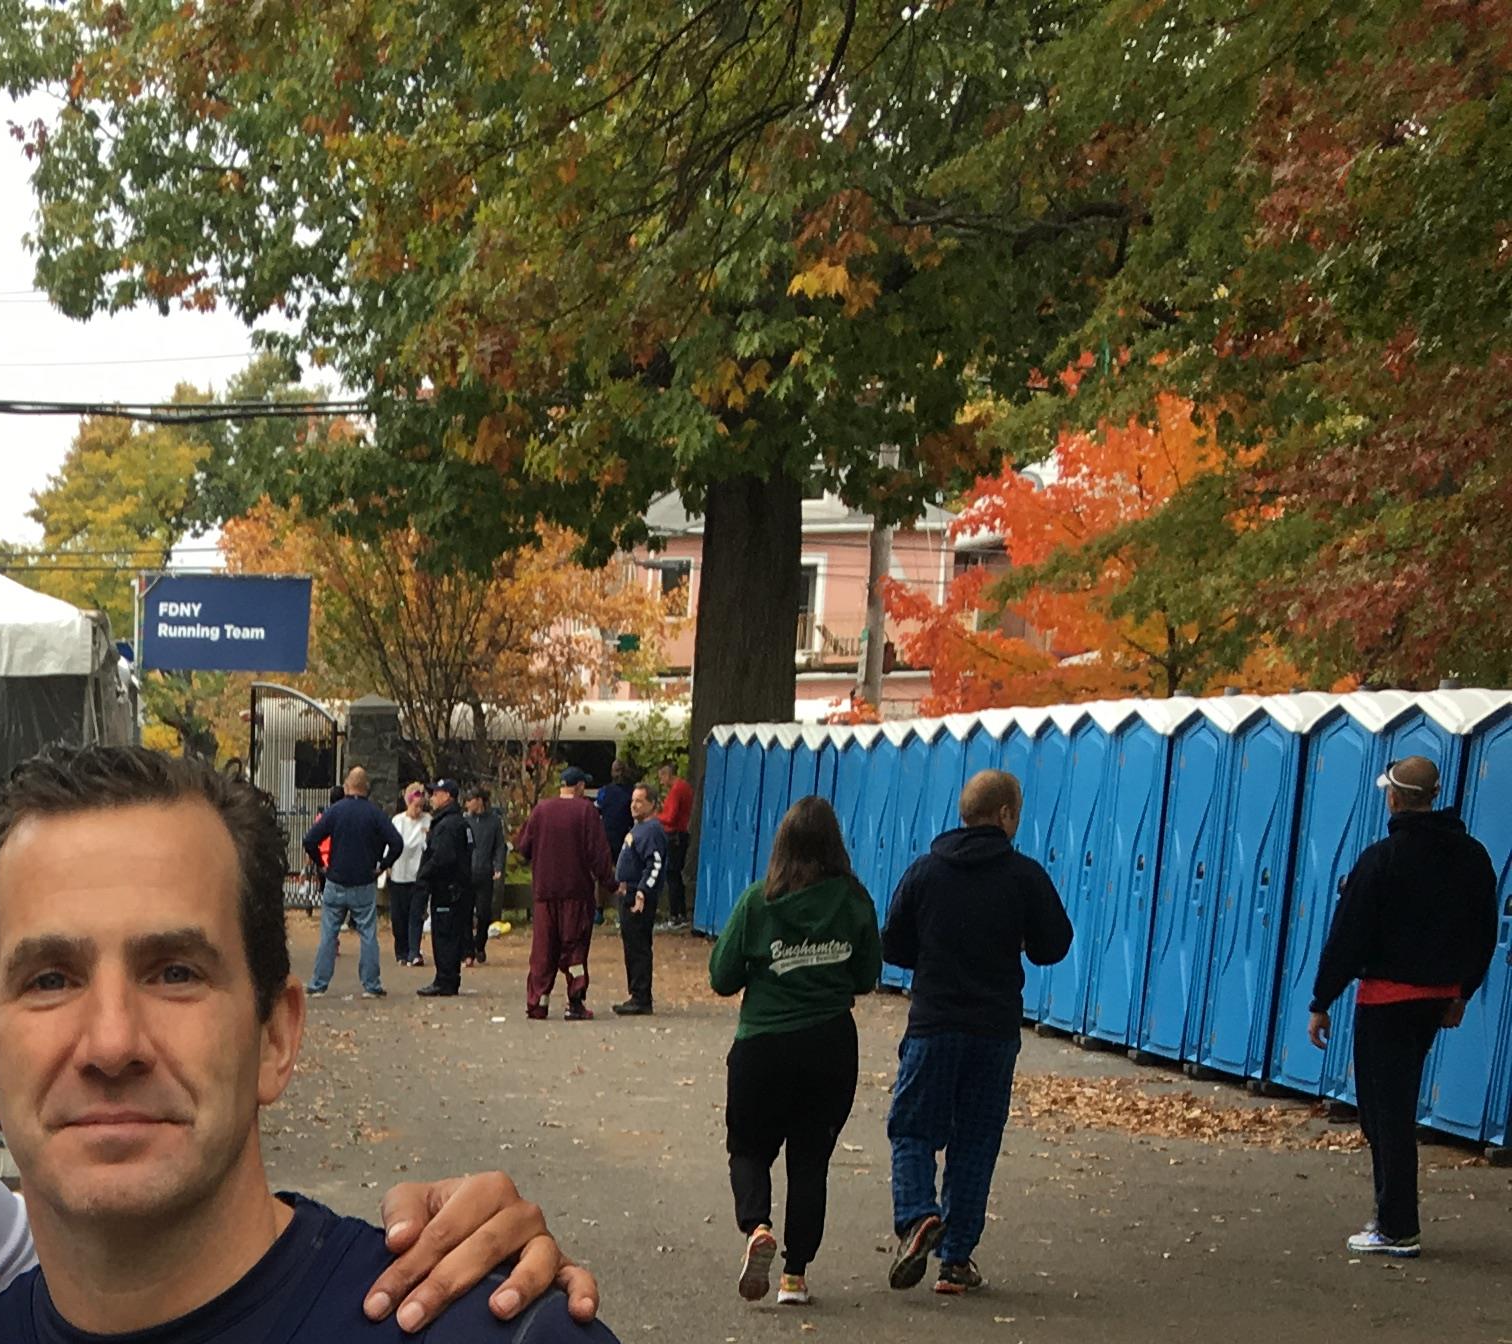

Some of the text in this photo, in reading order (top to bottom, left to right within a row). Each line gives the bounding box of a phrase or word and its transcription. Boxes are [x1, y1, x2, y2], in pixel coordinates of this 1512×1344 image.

[158, 602, 202, 618] FDNY
[157, 622, 265, 641] Running Team
